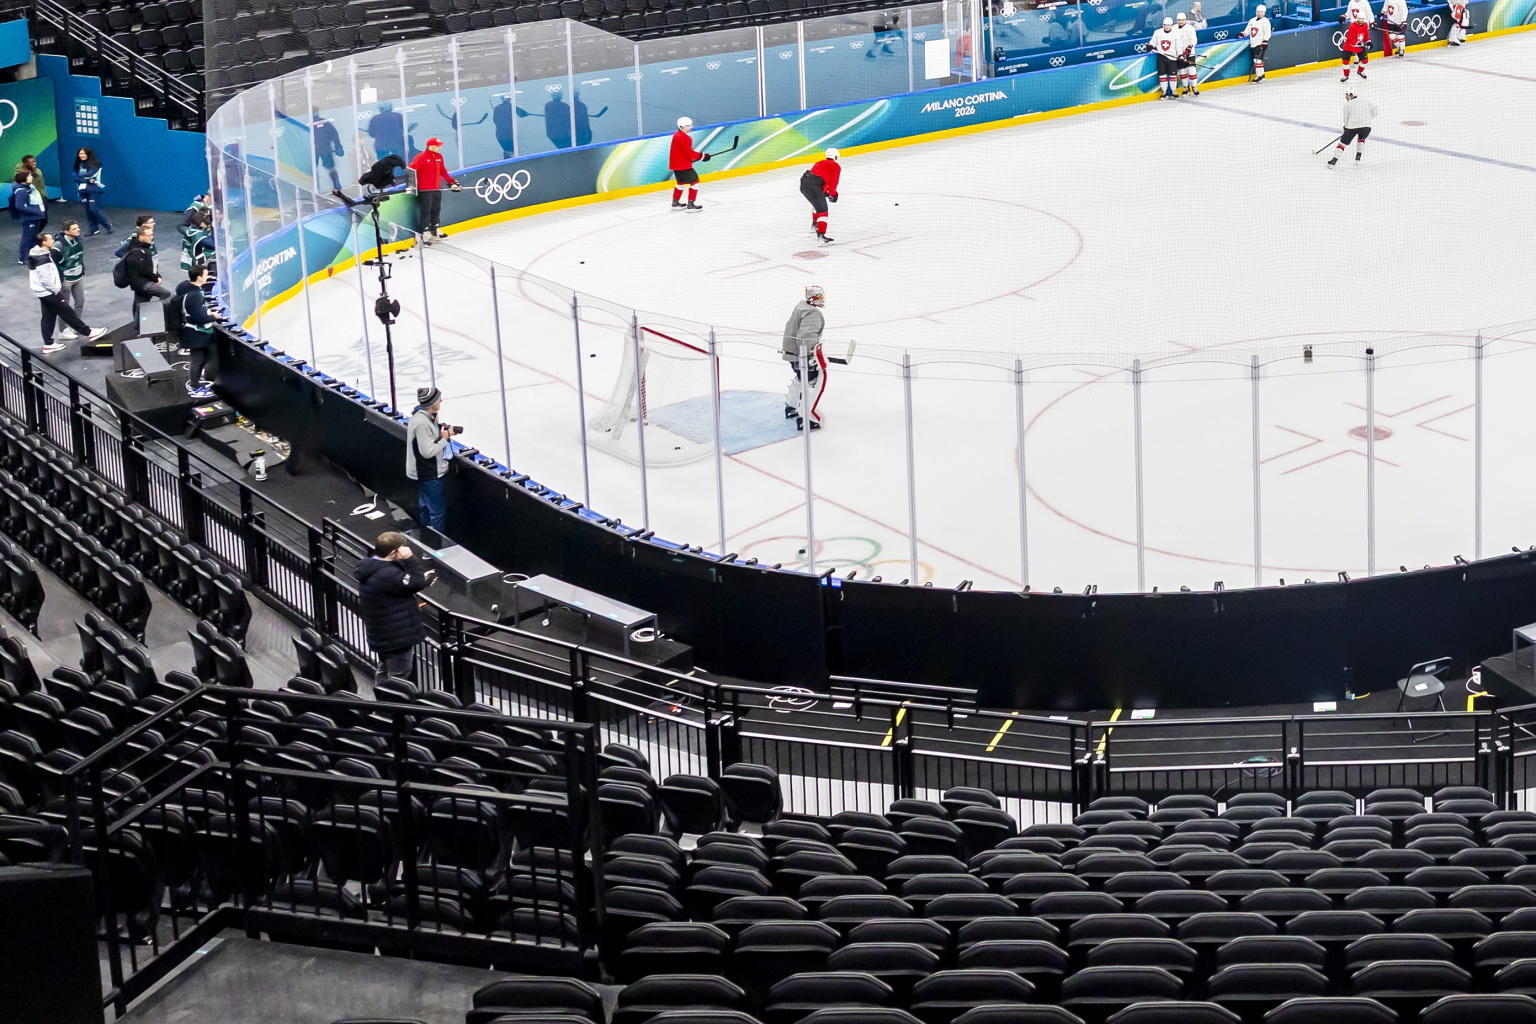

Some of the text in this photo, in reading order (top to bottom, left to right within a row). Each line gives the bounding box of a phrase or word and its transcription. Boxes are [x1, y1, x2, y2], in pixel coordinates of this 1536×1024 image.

[921, 90, 1008, 113] MILANO CORTINA
[954, 105, 976, 117] 2026
